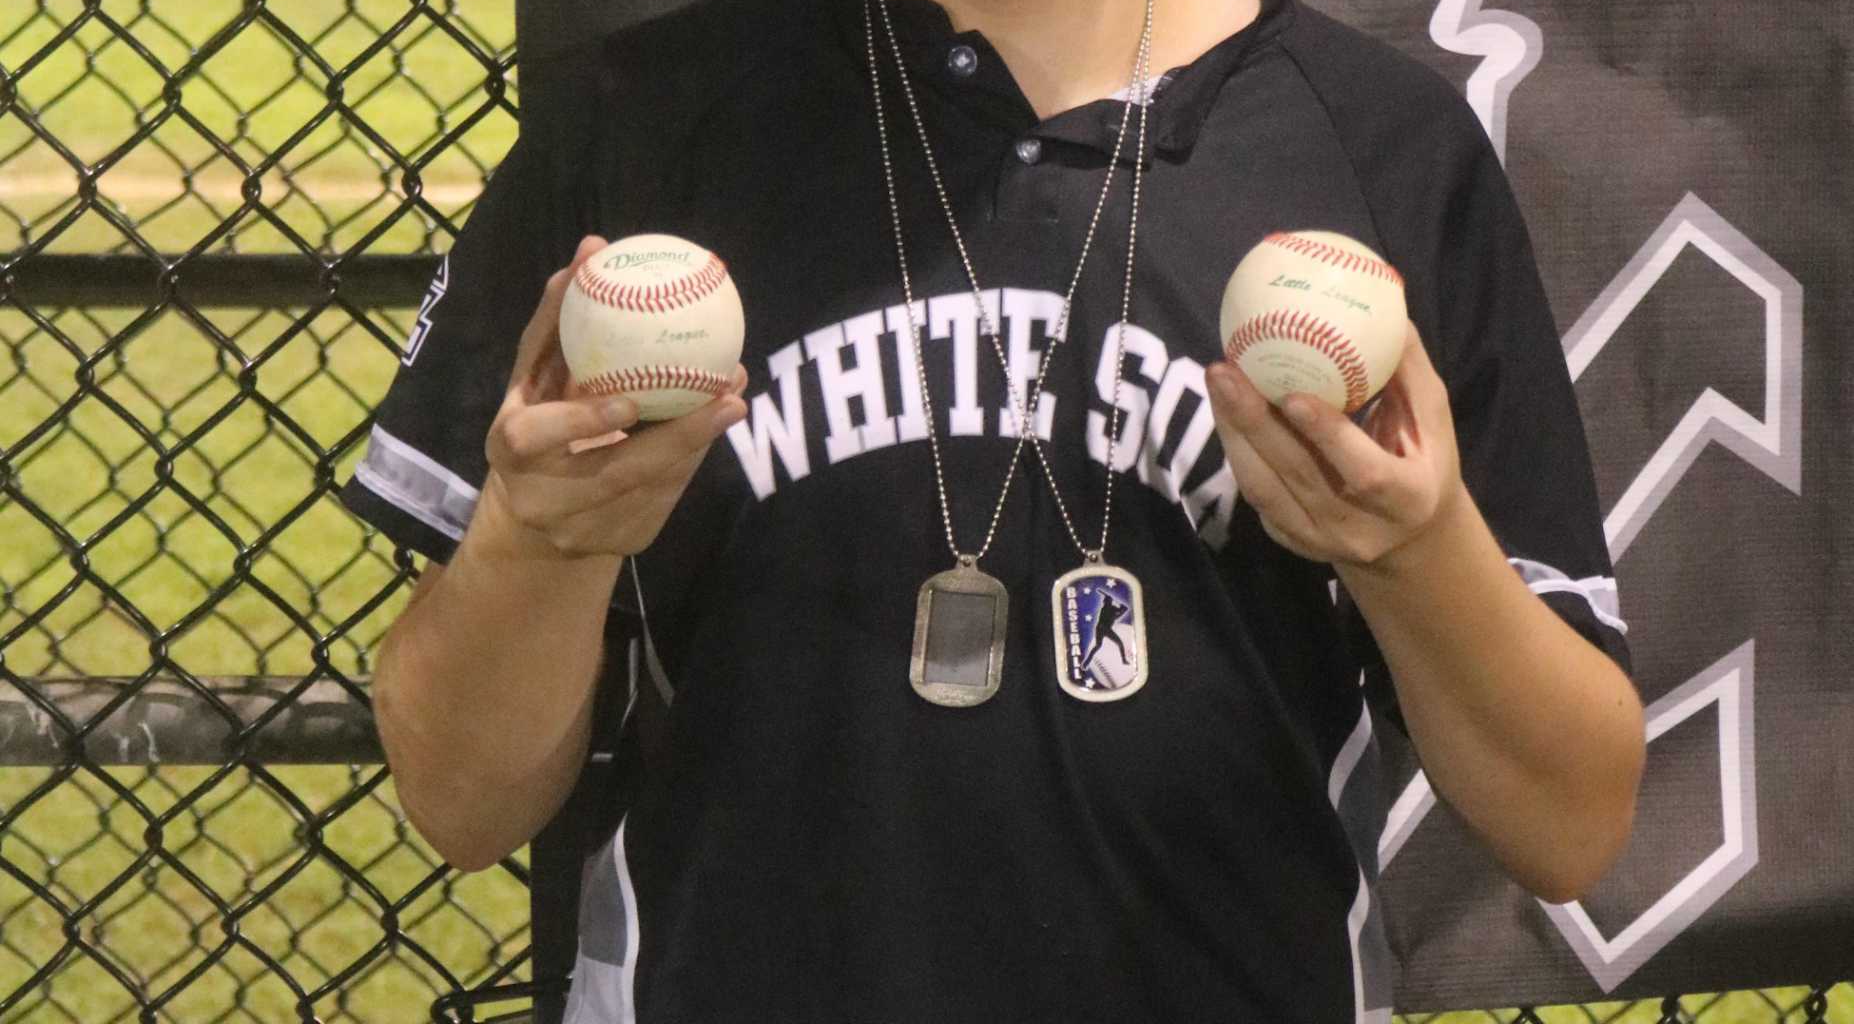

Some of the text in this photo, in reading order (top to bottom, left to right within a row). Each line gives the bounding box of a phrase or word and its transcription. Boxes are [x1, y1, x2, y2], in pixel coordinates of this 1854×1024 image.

[603, 250, 691, 271] Diamond
[1268, 274, 1312, 291] Little
[724, 287, 1069, 502] WHITE
[1065, 585, 1083, 681] BASEBALL
